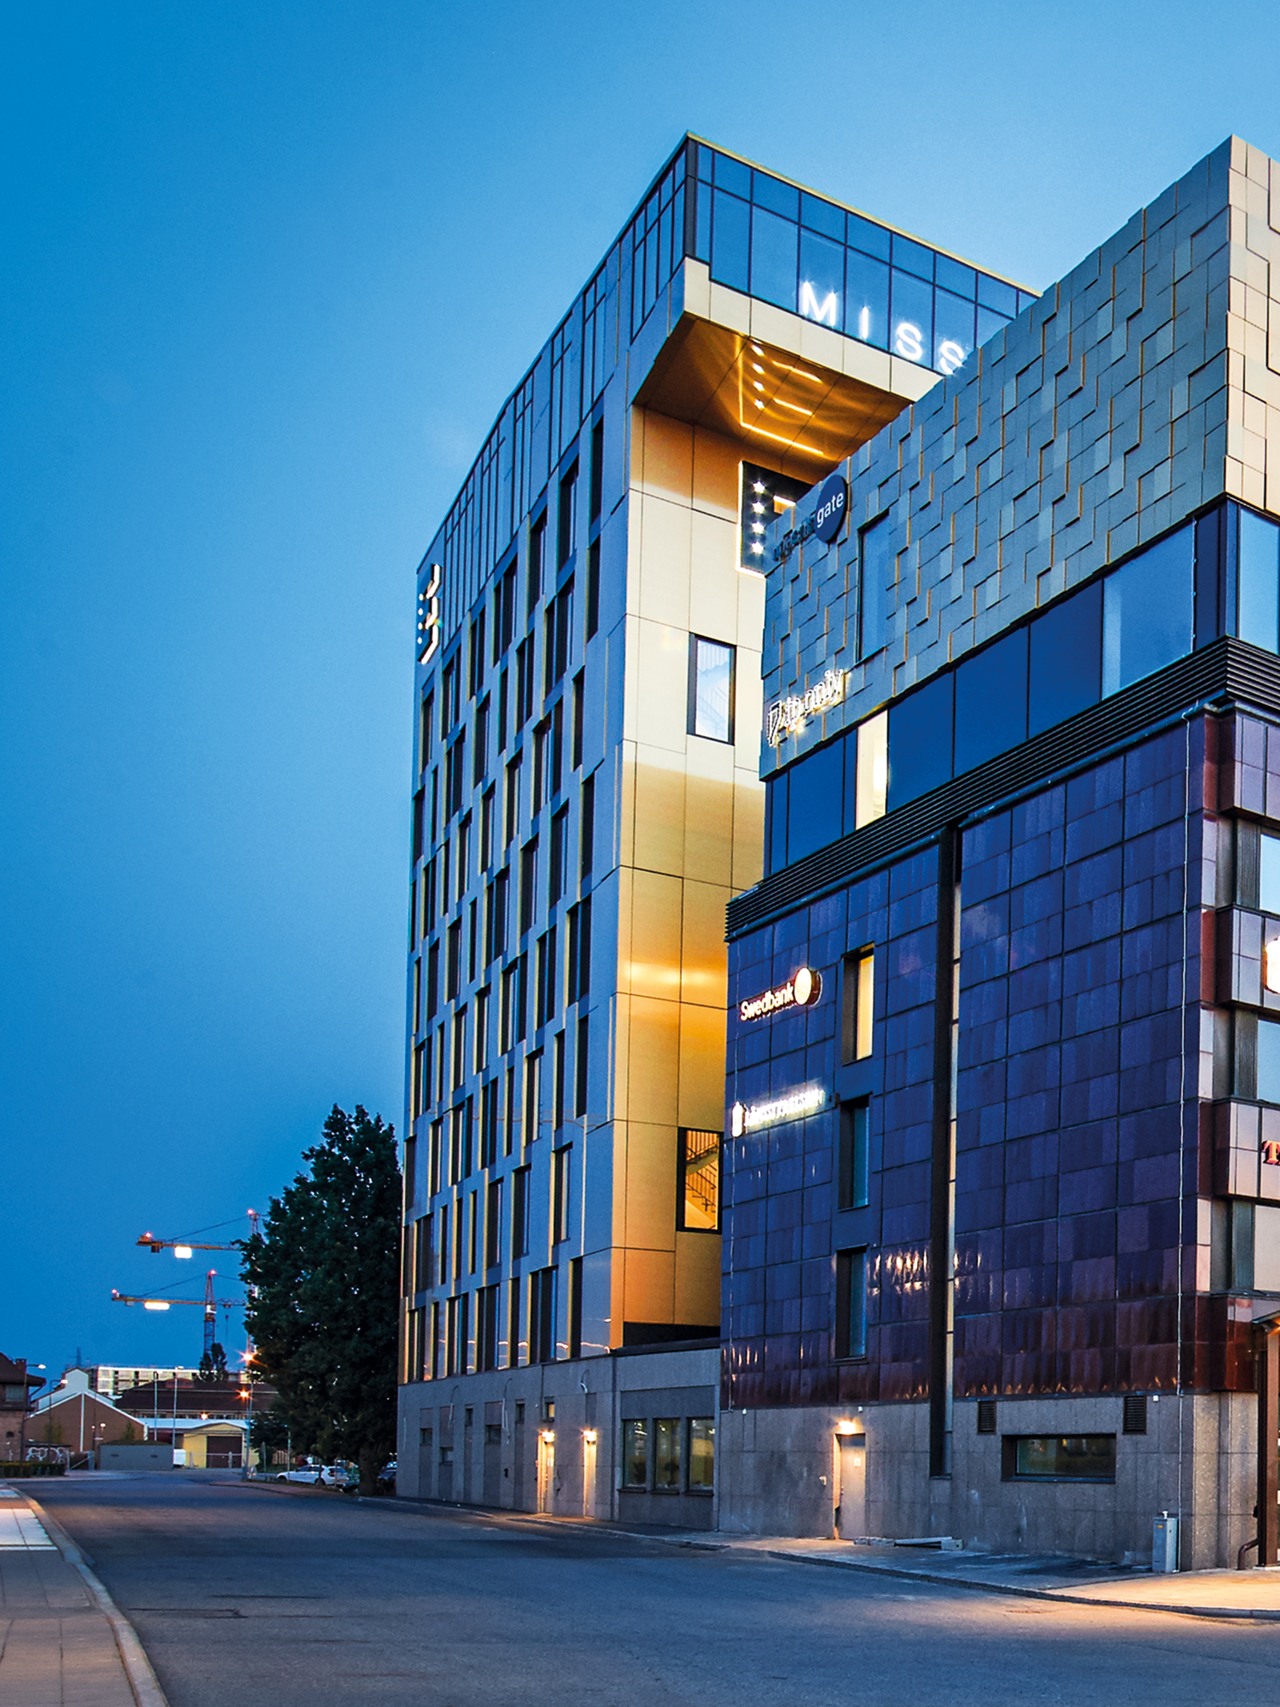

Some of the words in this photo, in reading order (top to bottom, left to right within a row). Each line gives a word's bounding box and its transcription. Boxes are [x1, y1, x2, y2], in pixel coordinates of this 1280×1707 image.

[801, 280, 964, 375] MISS
[816, 492, 844, 528] gate
[740, 981, 794, 1021] Swedbank
